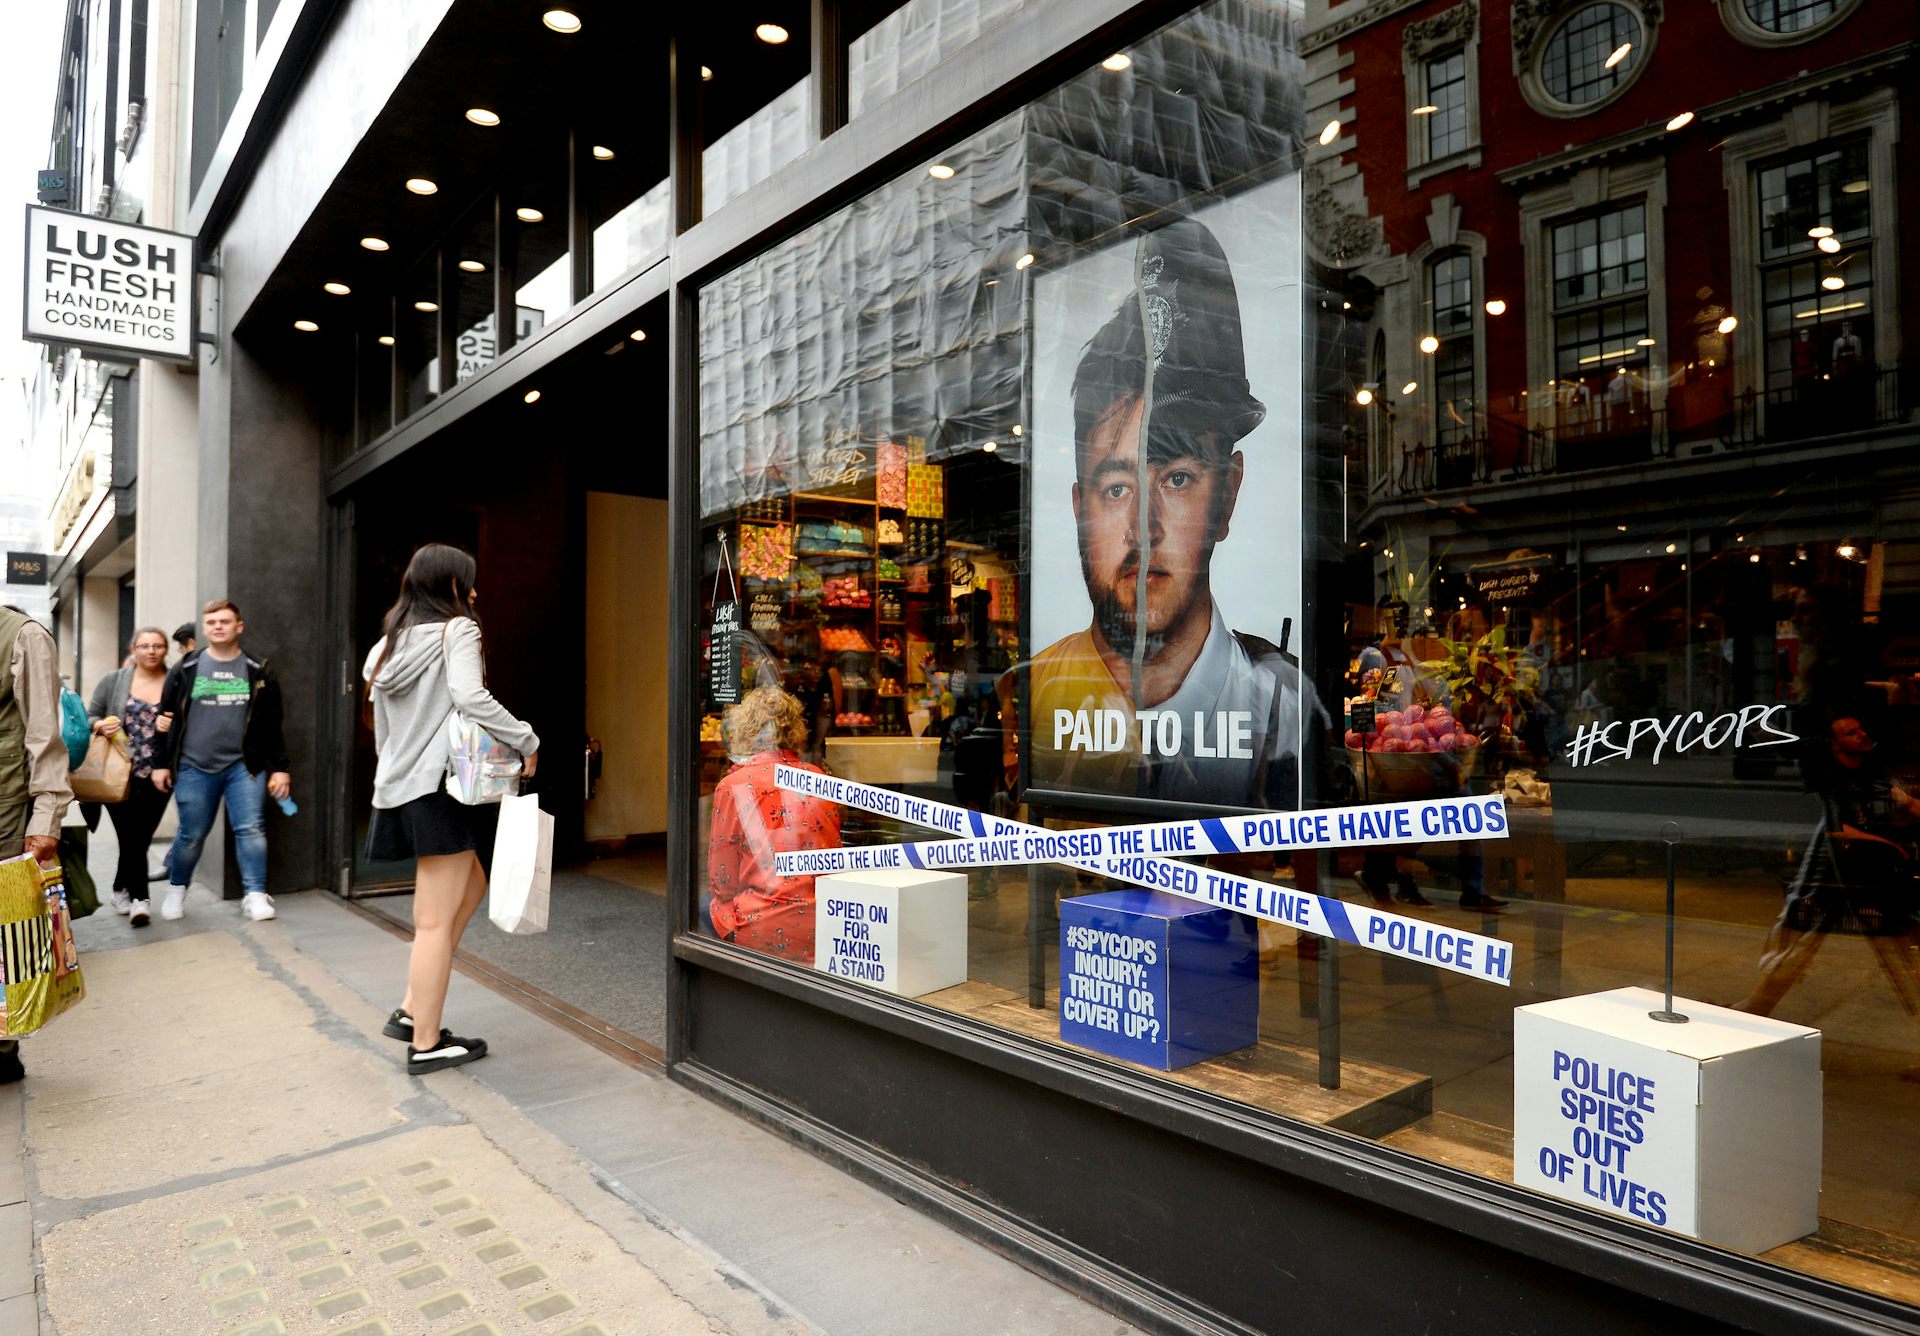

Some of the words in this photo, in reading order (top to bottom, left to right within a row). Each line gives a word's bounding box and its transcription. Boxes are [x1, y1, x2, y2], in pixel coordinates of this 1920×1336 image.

[39, 176, 65, 189] M&S
[46, 224, 176, 274] LUSH
[46, 258, 176, 304] FRESH
[45, 288, 176, 323] HANDMADE
[45, 309, 176, 341] COSMETICS
[808, 466, 868, 486] STREET
[13, 561, 41, 572] M&S
[1053, 708, 1127, 752] PAID
[1135, 710, 1182, 757] TO
[1194, 711, 1254, 759] LIE
[1565, 704, 1800, 768] #SPYCOPS
[777, 768, 812, 793] POLICE
[815, 777, 843, 800] HAVE
[846, 785, 900, 815] CROSSED
[904, 800, 928, 824] THE
[932, 807, 963, 833] LINE
[797, 851, 845, 872] CROSSED
[848, 850, 869, 868] THE
[873, 848, 900, 868] LINE
[927, 843, 976, 865] POLICE
[980, 839, 1020, 863] HAVE
[1024, 833, 1101, 860] CROSSED
[1107, 830, 1144, 855] THE
[1151, 826, 1196, 852] LINE
[1243, 815, 1330, 847] POLICE
[1338, 808, 1412, 841] HAVE
[1421, 800, 1505, 836] CROS
[827, 899, 864, 920] SPIED
[869, 905, 887, 924] ON
[844, 920, 869, 941] FOR
[1206, 874, 1248, 908] THE
[1256, 887, 1310, 926] LINE
[1368, 915, 1473, 970] POLICE
[1485, 945, 1511, 980] H
[833, 937, 880, 962] TAKING
[1066, 925, 1157, 965] #SPYCOPS
[828, 956, 837, 974] A
[841, 958, 885, 982] STAND
[1075, 950, 1147, 989] INQUIRY:
[1068, 973, 1123, 1009] TRUTH
[1128, 988, 1155, 1017] OR
[1064, 997, 1119, 1034] COVER
[1124, 1012, 1160, 1044] UP?
[1553, 1049, 1655, 1114] POLICE
[1560, 1087, 1644, 1144] SPIES
[1572, 1126, 1631, 1174] OUT
[1539, 1146, 1574, 1184] OF
[1583, 1163, 1667, 1226] LIVES
